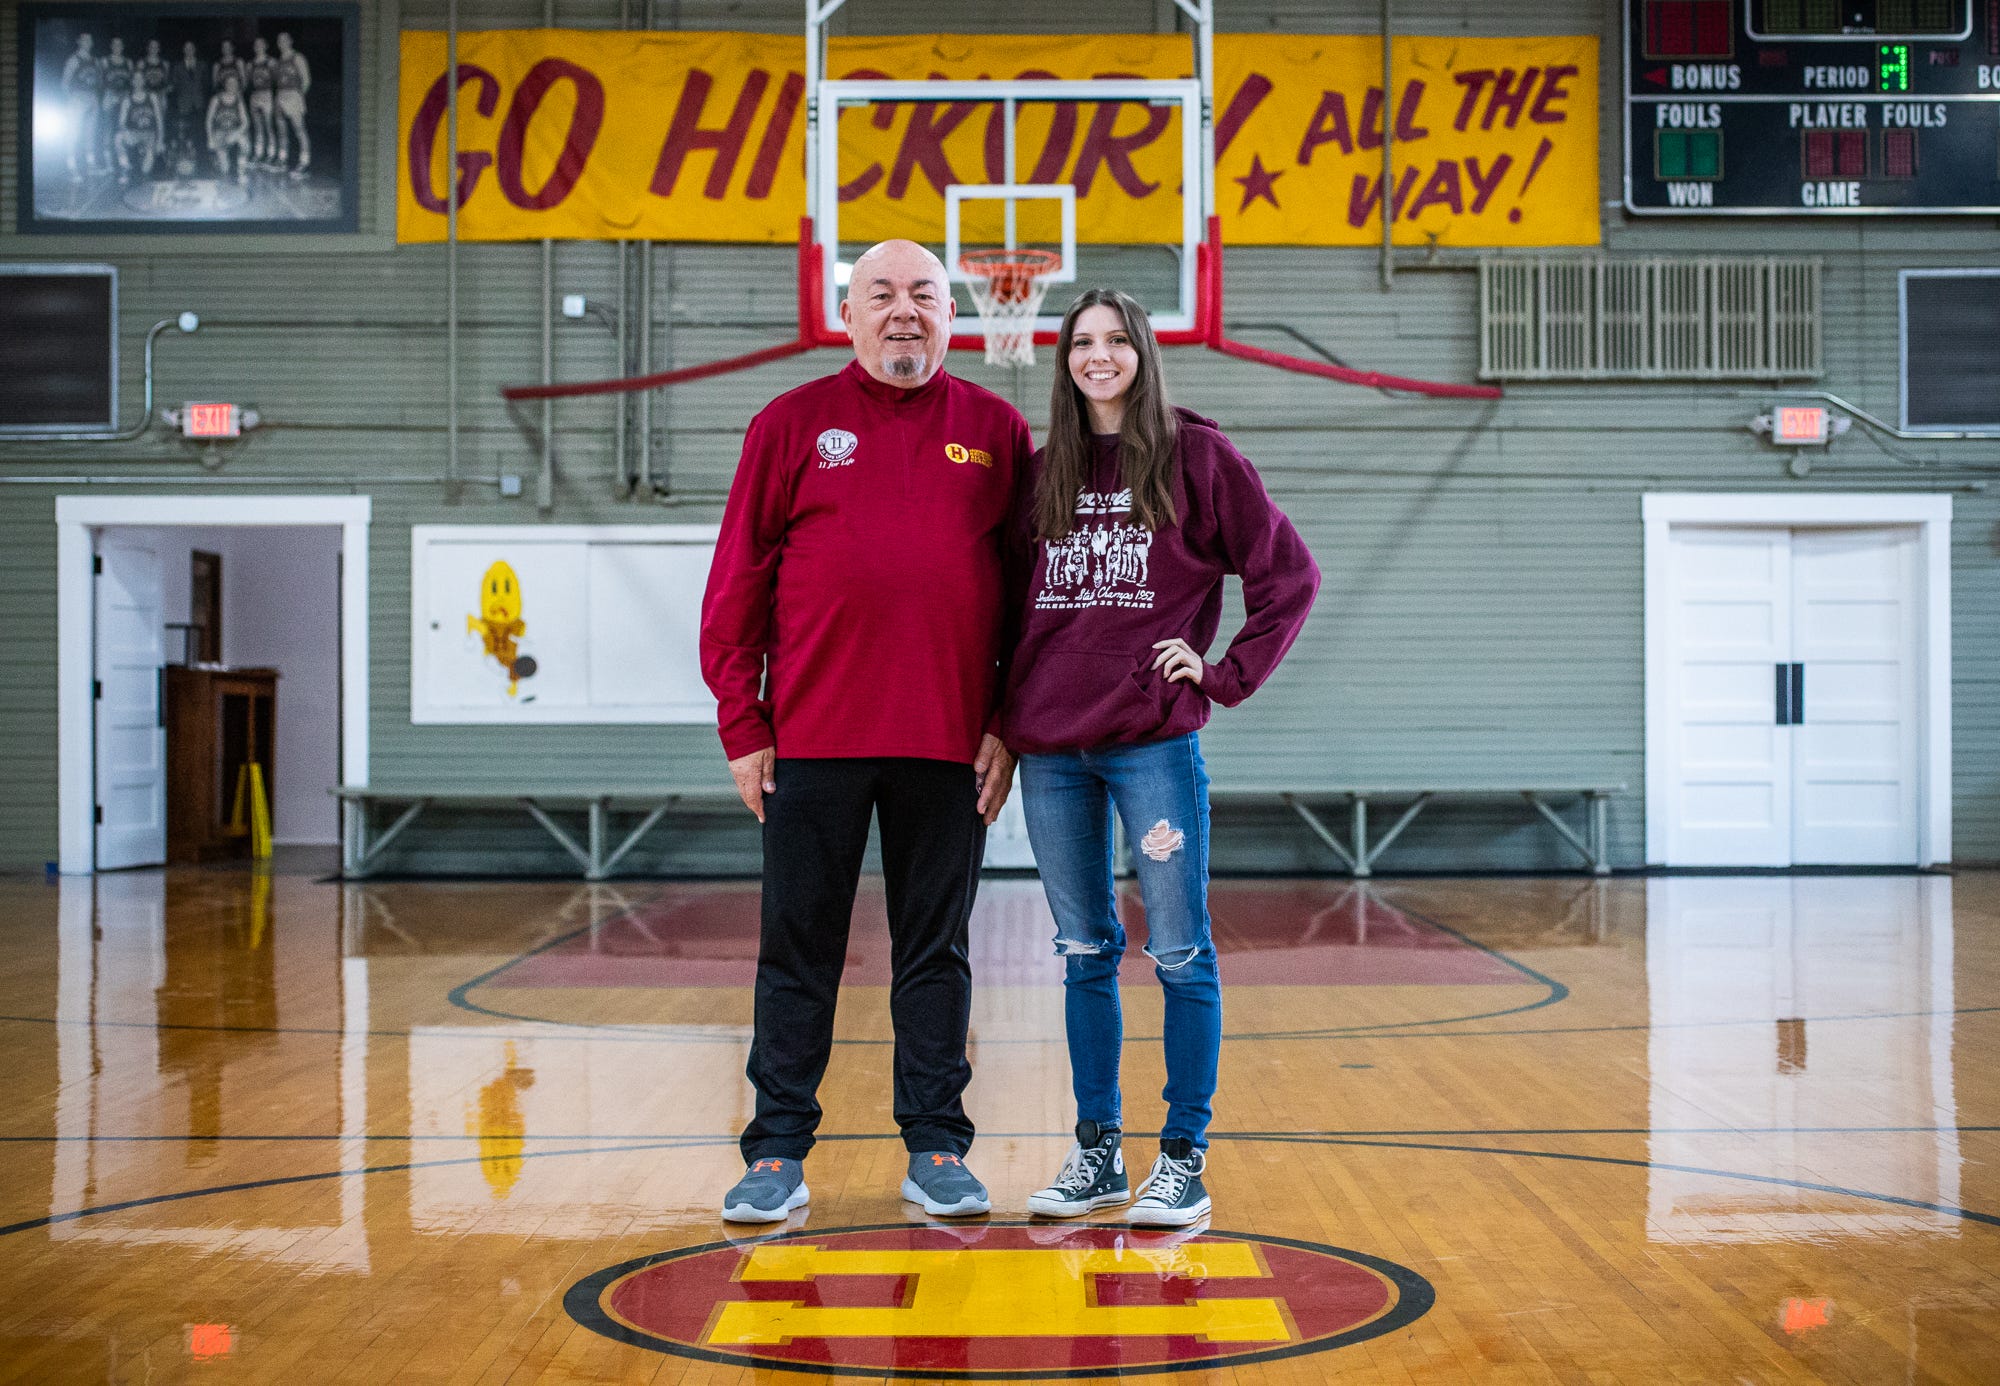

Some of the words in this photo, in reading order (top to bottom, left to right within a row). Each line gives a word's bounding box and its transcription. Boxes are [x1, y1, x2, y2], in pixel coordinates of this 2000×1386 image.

[1671, 65, 1741, 89] BONUS
[1803, 66, 1870, 88] PERIOD
[1296, 78, 1429, 166] ALL
[1453, 64, 1578, 132] THE
[1656, 103, 1722, 127] FOULS
[1789, 103, 1867, 127] PLAYER
[1882, 103, 1948, 127] FOULS
[408, 57, 605, 215] GO
[1347, 137, 1553, 228] WAY!
[1667, 182, 1713, 206] WON
[1802, 182, 1861, 206] GAME
[192, 406, 230, 433] EXIT
[1783, 410, 1821, 435] EXIT
[830, 437, 842, 449] 11
[951, 446, 963, 460] H
[818, 461, 827, 469] 11
[1034, 600, 1098, 609] CELEBRATIG
[1116, 600, 1153, 609] YEARS
[1097, 585, 1134, 602] Champs
[1135, 589, 1155, 601] 1952
